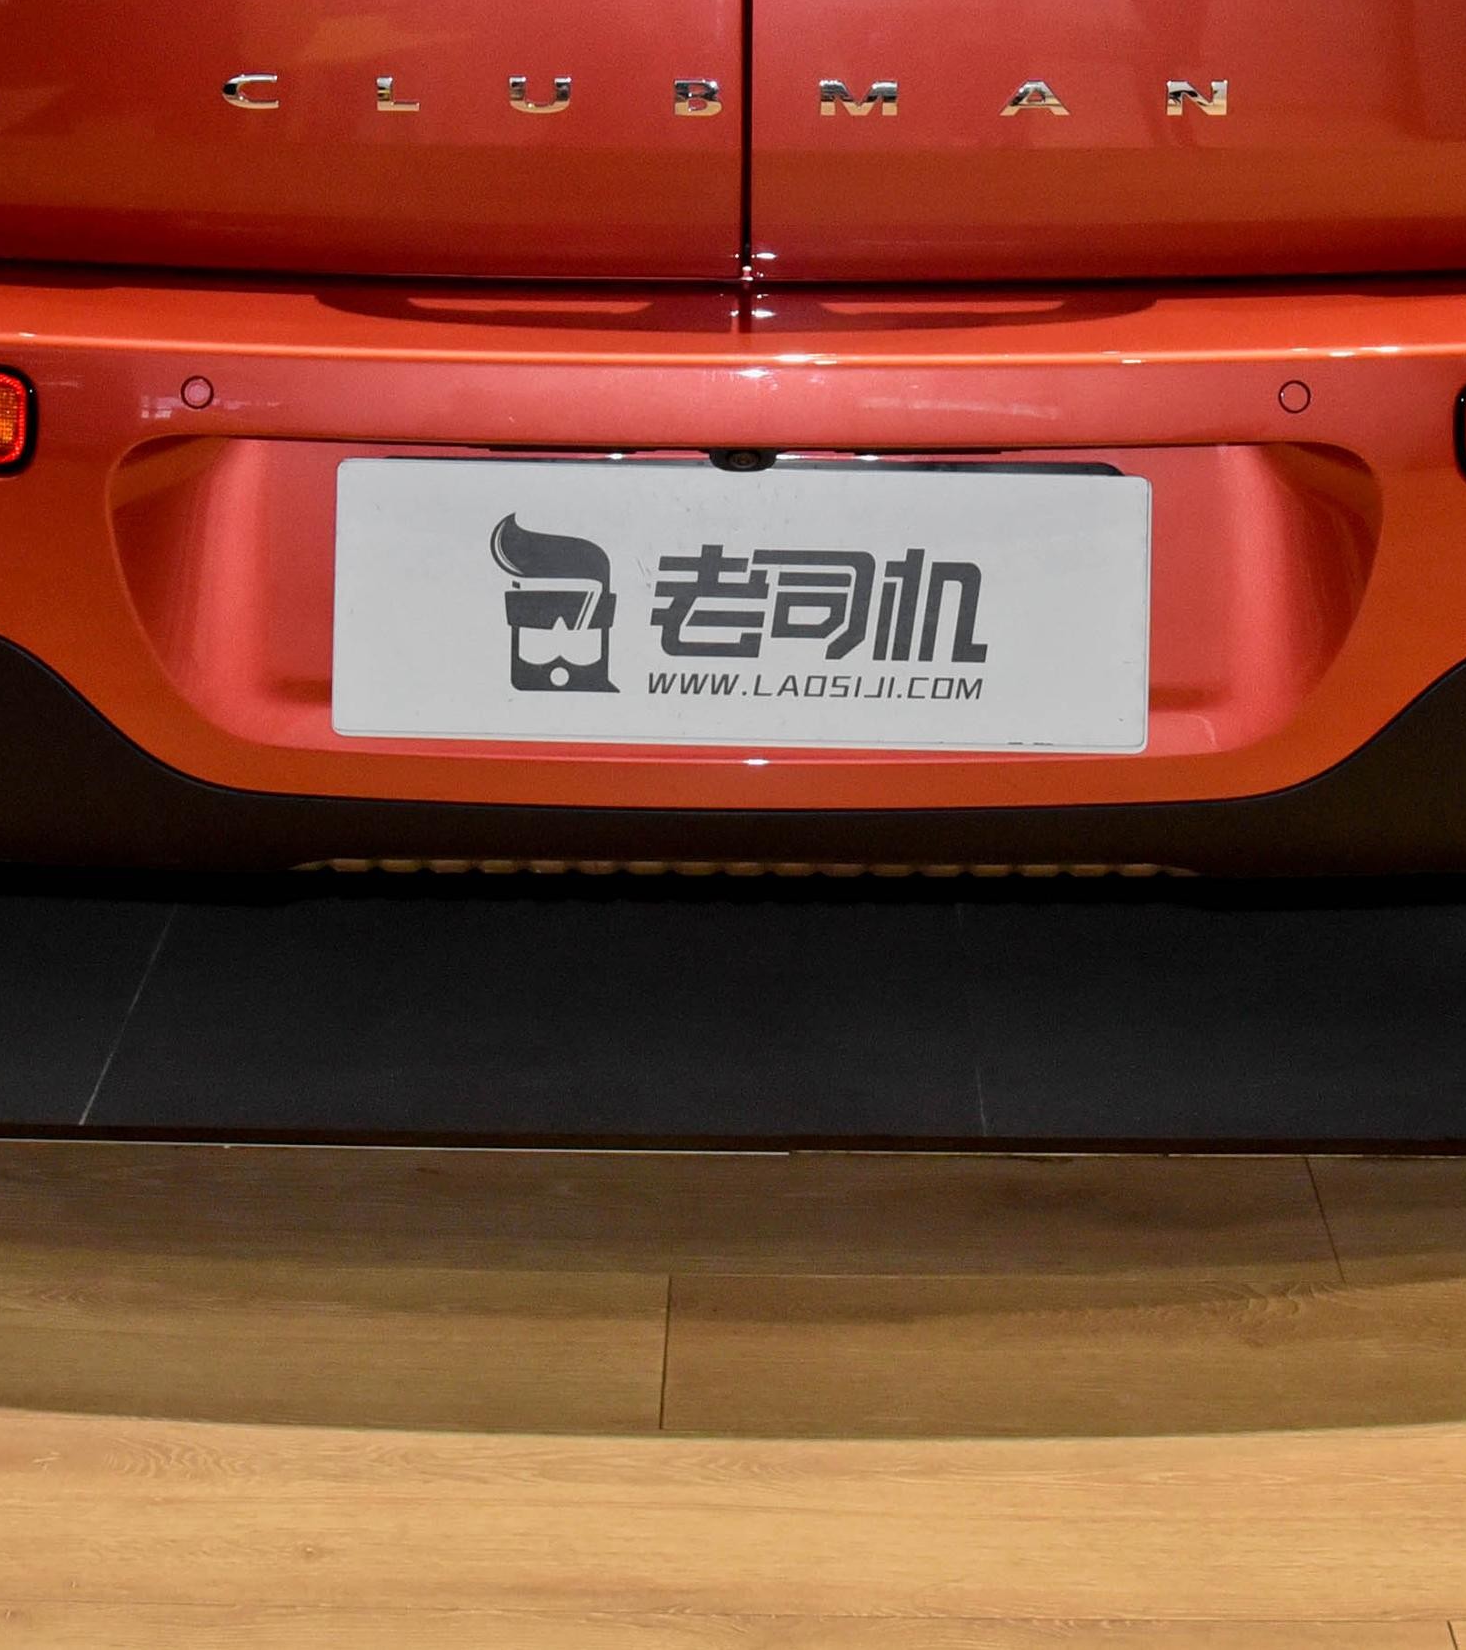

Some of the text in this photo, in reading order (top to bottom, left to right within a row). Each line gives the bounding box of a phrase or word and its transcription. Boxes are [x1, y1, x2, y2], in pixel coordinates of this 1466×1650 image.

[223, 73, 1228, 116] CLUBMAN
[650, 544, 988, 663] 老司机
[648, 672, 984, 700] WWW.LAOSIJI.COM
